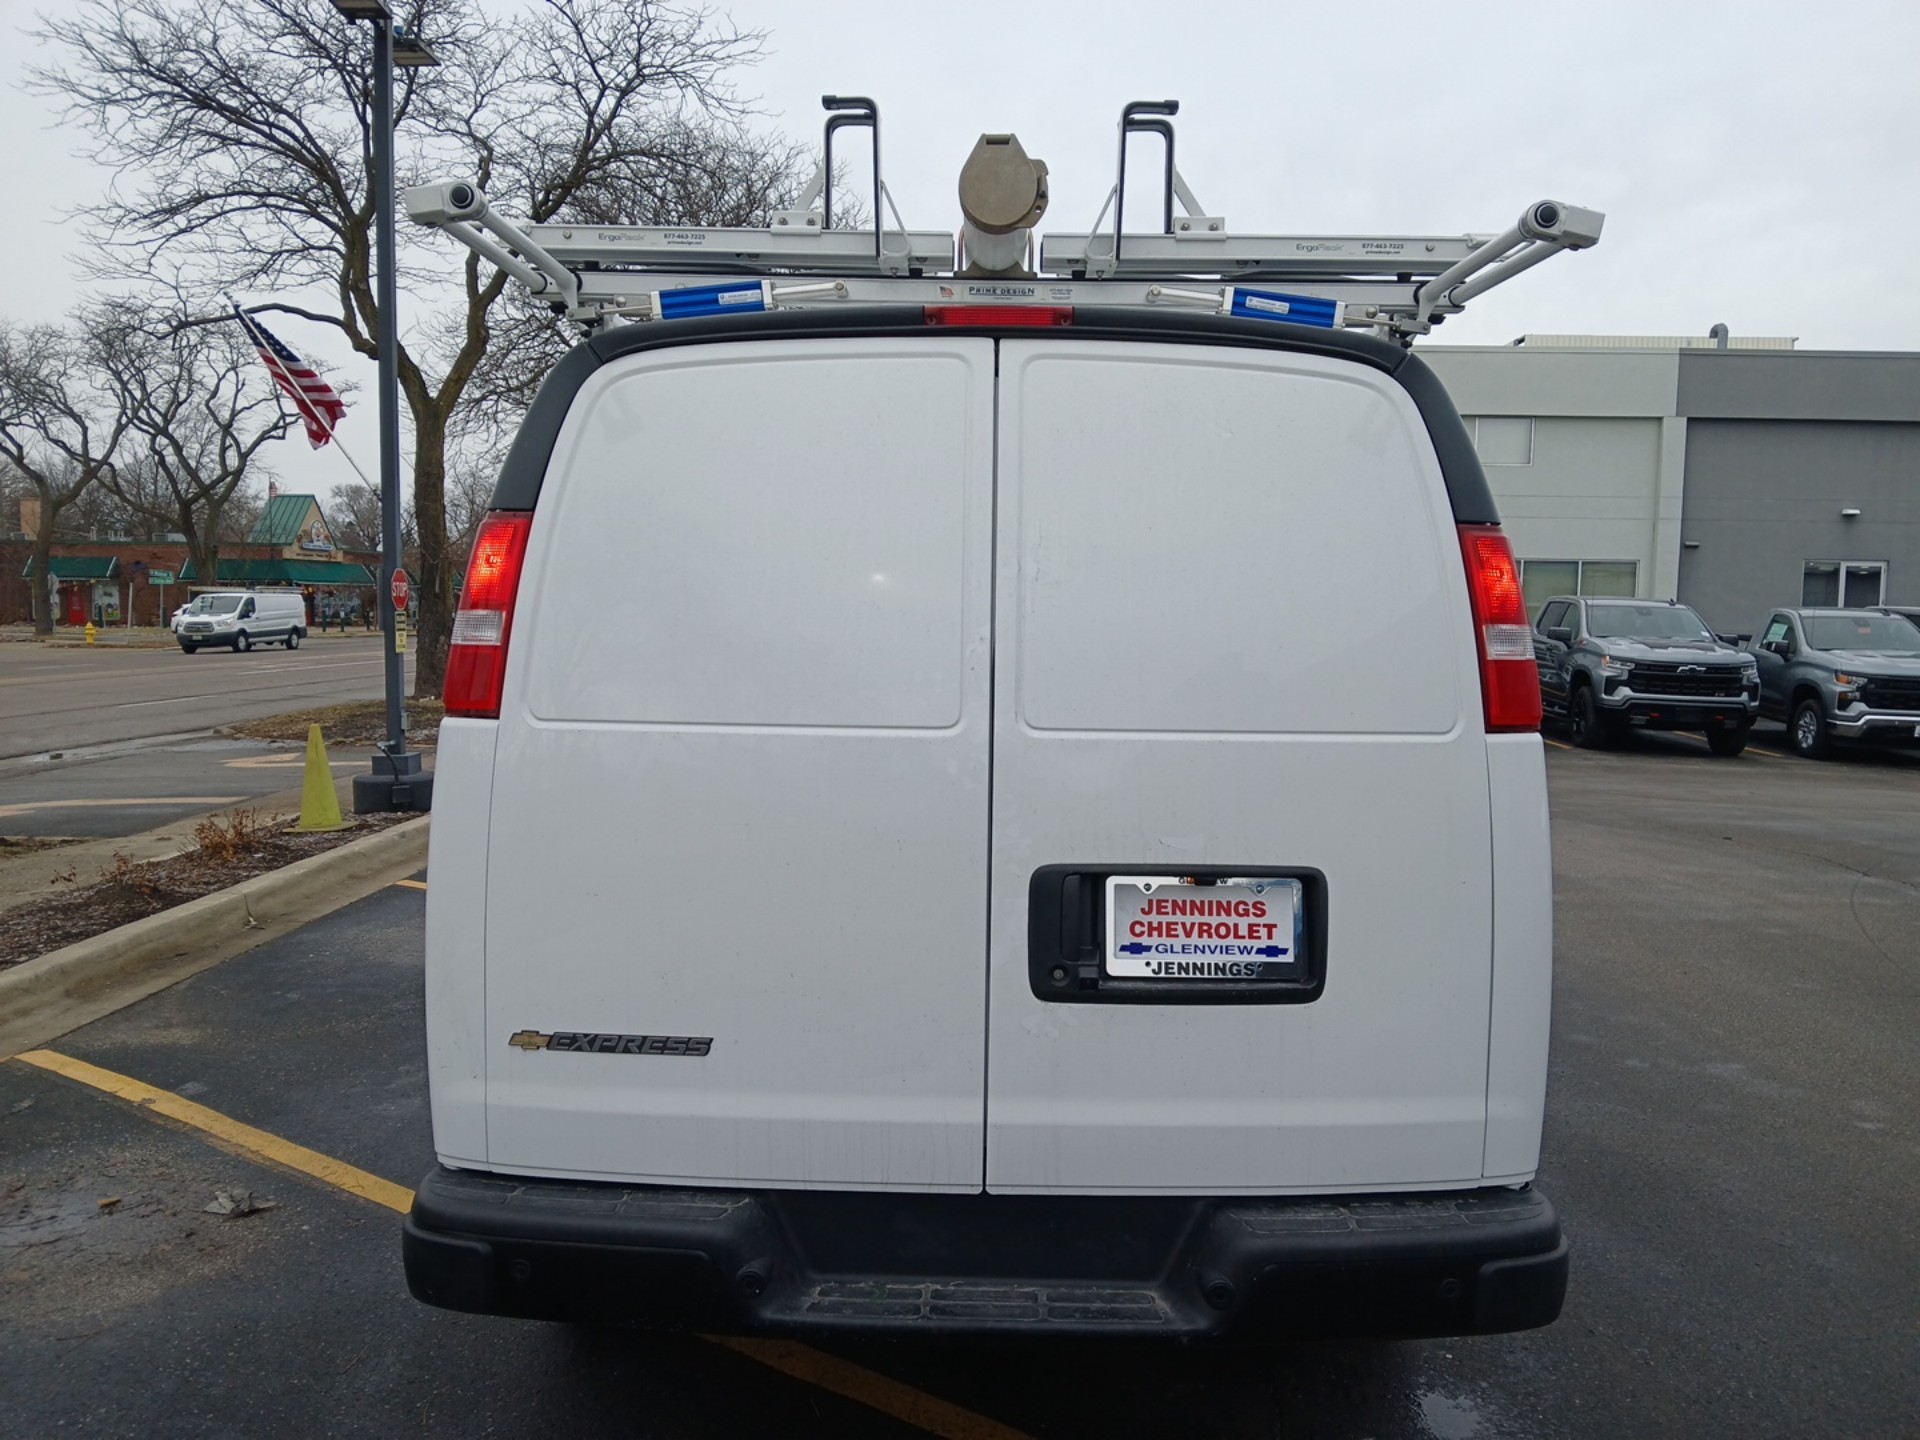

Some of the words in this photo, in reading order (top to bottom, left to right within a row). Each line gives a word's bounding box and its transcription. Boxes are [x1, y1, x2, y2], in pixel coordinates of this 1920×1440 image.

[392, 582, 408, 597] STOP
[1140, 898, 1267, 918] JENNINGS
[1129, 920, 1278, 940] CHEVROLET
[1155, 943, 1255, 955] GLENVIEW
[1151, 961, 1256, 977] JENNINGS
[549, 1032, 713, 1056] EXPRESS
